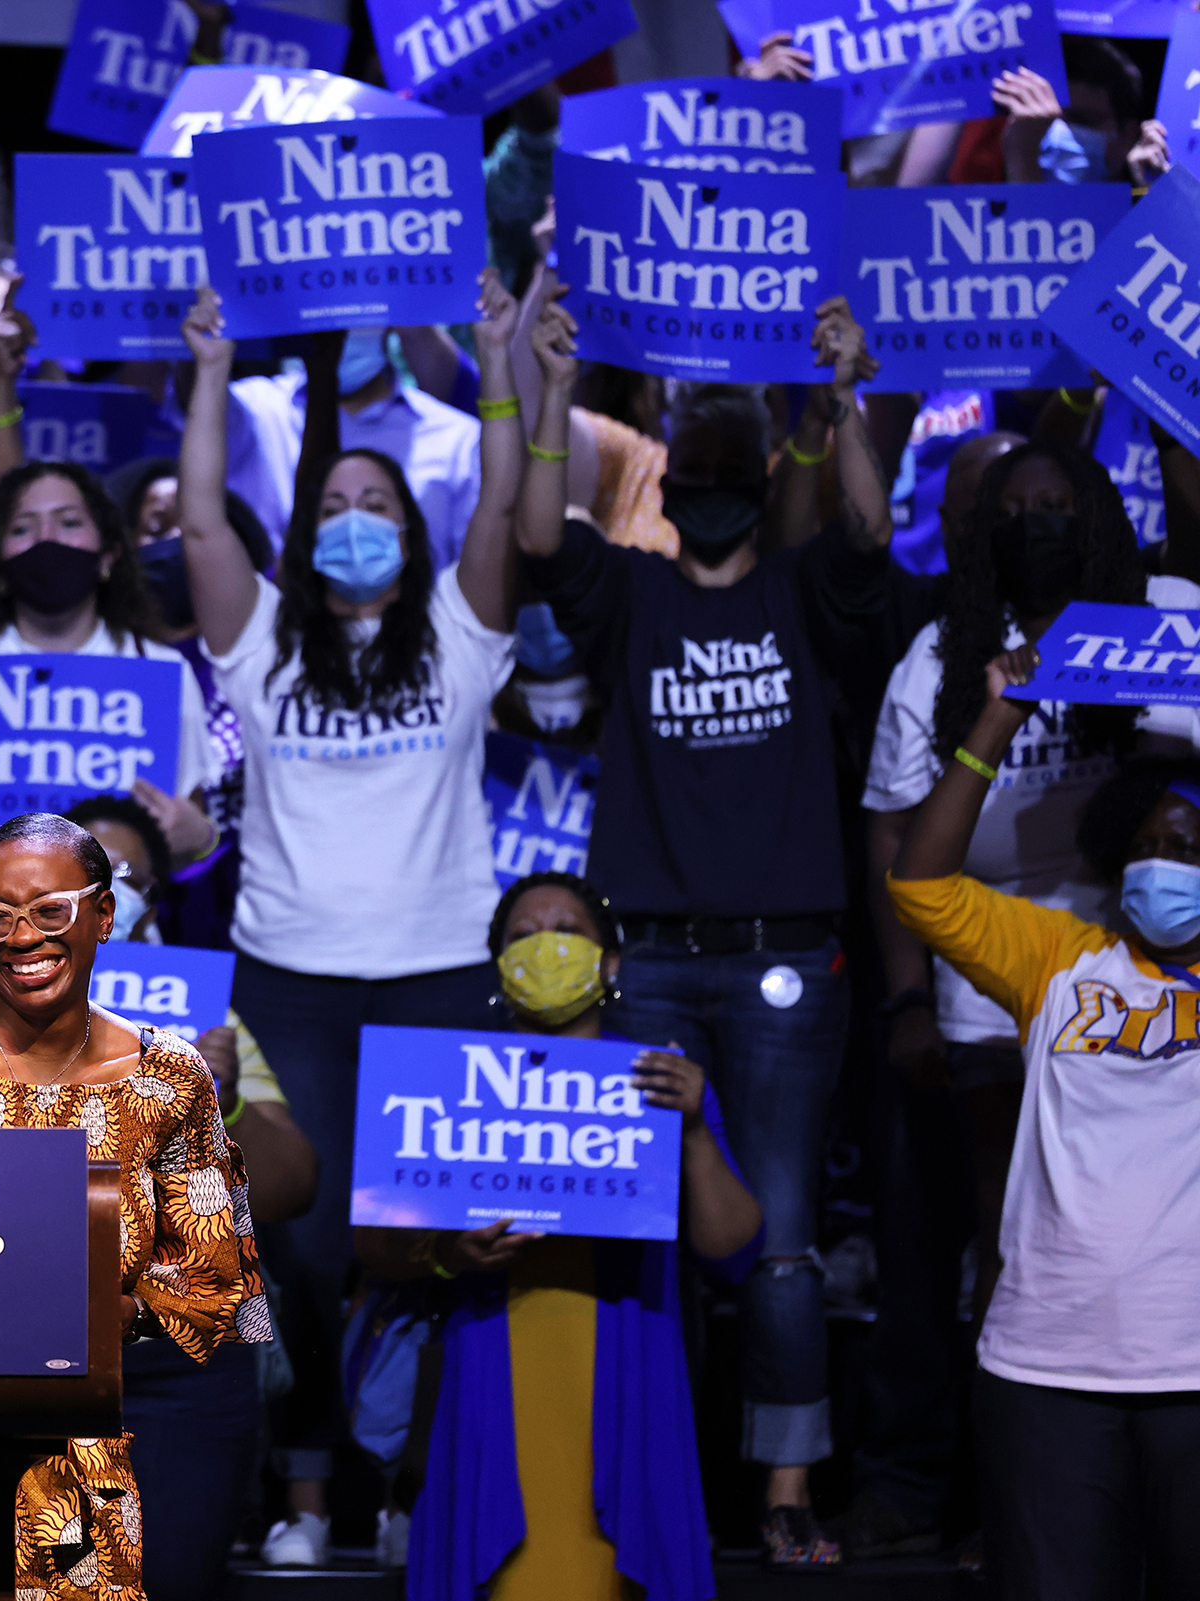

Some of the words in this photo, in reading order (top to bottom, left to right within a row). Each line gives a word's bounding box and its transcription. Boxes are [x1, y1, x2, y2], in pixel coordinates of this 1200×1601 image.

[794, 1, 1033, 81] Turner
[640, 89, 808, 155] Nina
[274, 133, 453, 205] Nina
[218, 198, 464, 268] Turner
[634, 177, 811, 255] Nina
[925, 197, 1095, 266] Nina
[238, 274, 286, 297] FOR
[299, 264, 455, 291] CONGRESS
[574, 225, 818, 313] Turner
[858, 256, 1069, 324] Turne
[586, 303, 632, 329] FOR
[645, 314, 804, 342] CONGRESS
[1096, 299, 1146, 348] FOR
[680, 631, 784, 679] Nina
[650, 666, 793, 717] Turner
[457, 1043, 645, 1118] Nina
[382, 1094, 654, 1170] Turner
[394, 1168, 453, 1188] FOR
[470, 1171, 639, 1198] CONGRESS
